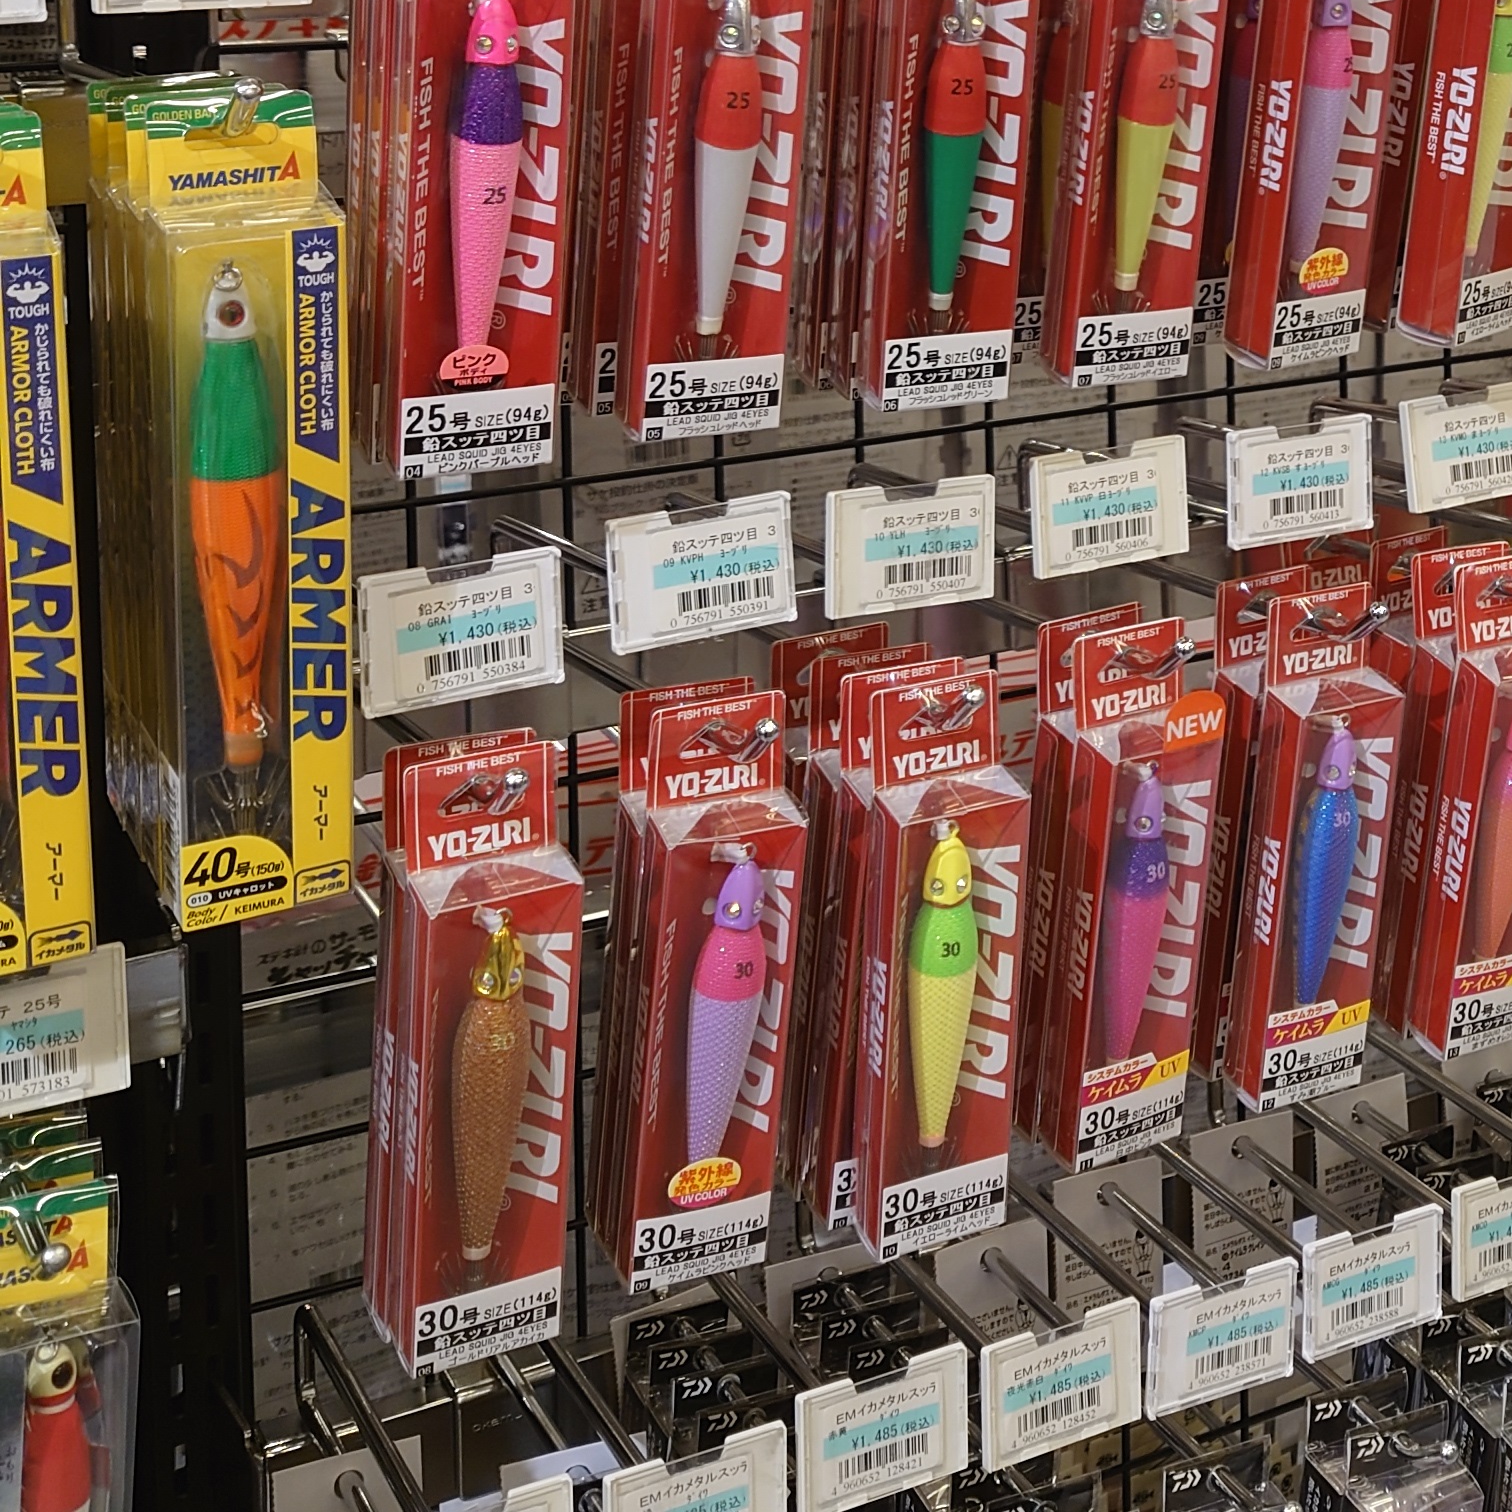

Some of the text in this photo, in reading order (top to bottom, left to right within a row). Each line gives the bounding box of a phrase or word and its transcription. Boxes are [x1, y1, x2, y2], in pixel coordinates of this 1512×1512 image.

[152, 108, 189, 123] GOLDEN
[727, 92, 751, 110] 25
[1258, 79, 1293, 193] YO-ZURI
[167, 150, 301, 192] YAMASHITA
[483, 187, 507, 205] 25
[297, 273, 335, 286] TOUGH
[298, 294, 317, 436] ARMOR CLOTH
[320, 291, 335, 432] かじられても破れにくい布
[451, 353, 497, 370] ピンク
[405, 403, 471, 436] 25号
[421, 425, 541, 451] 鉛スッテ四ツ目
[289, 475, 347, 743] ARMER
[431, 661, 526, 690] 756791 550384
[1167, 708, 1224, 742] NEW
[313, 785, 330, 841] アーマー
[427, 821, 532, 861] YO-ZURI
[189, 893, 210, 905] 010
[300, 879, 347, 897] イカメタル
[233, 896, 285, 915] KEIMURA
[734, 960, 754, 980] 30
[417, 1303, 479, 1338] 30号
[842, 1457, 924, 1492] 960652 128421
